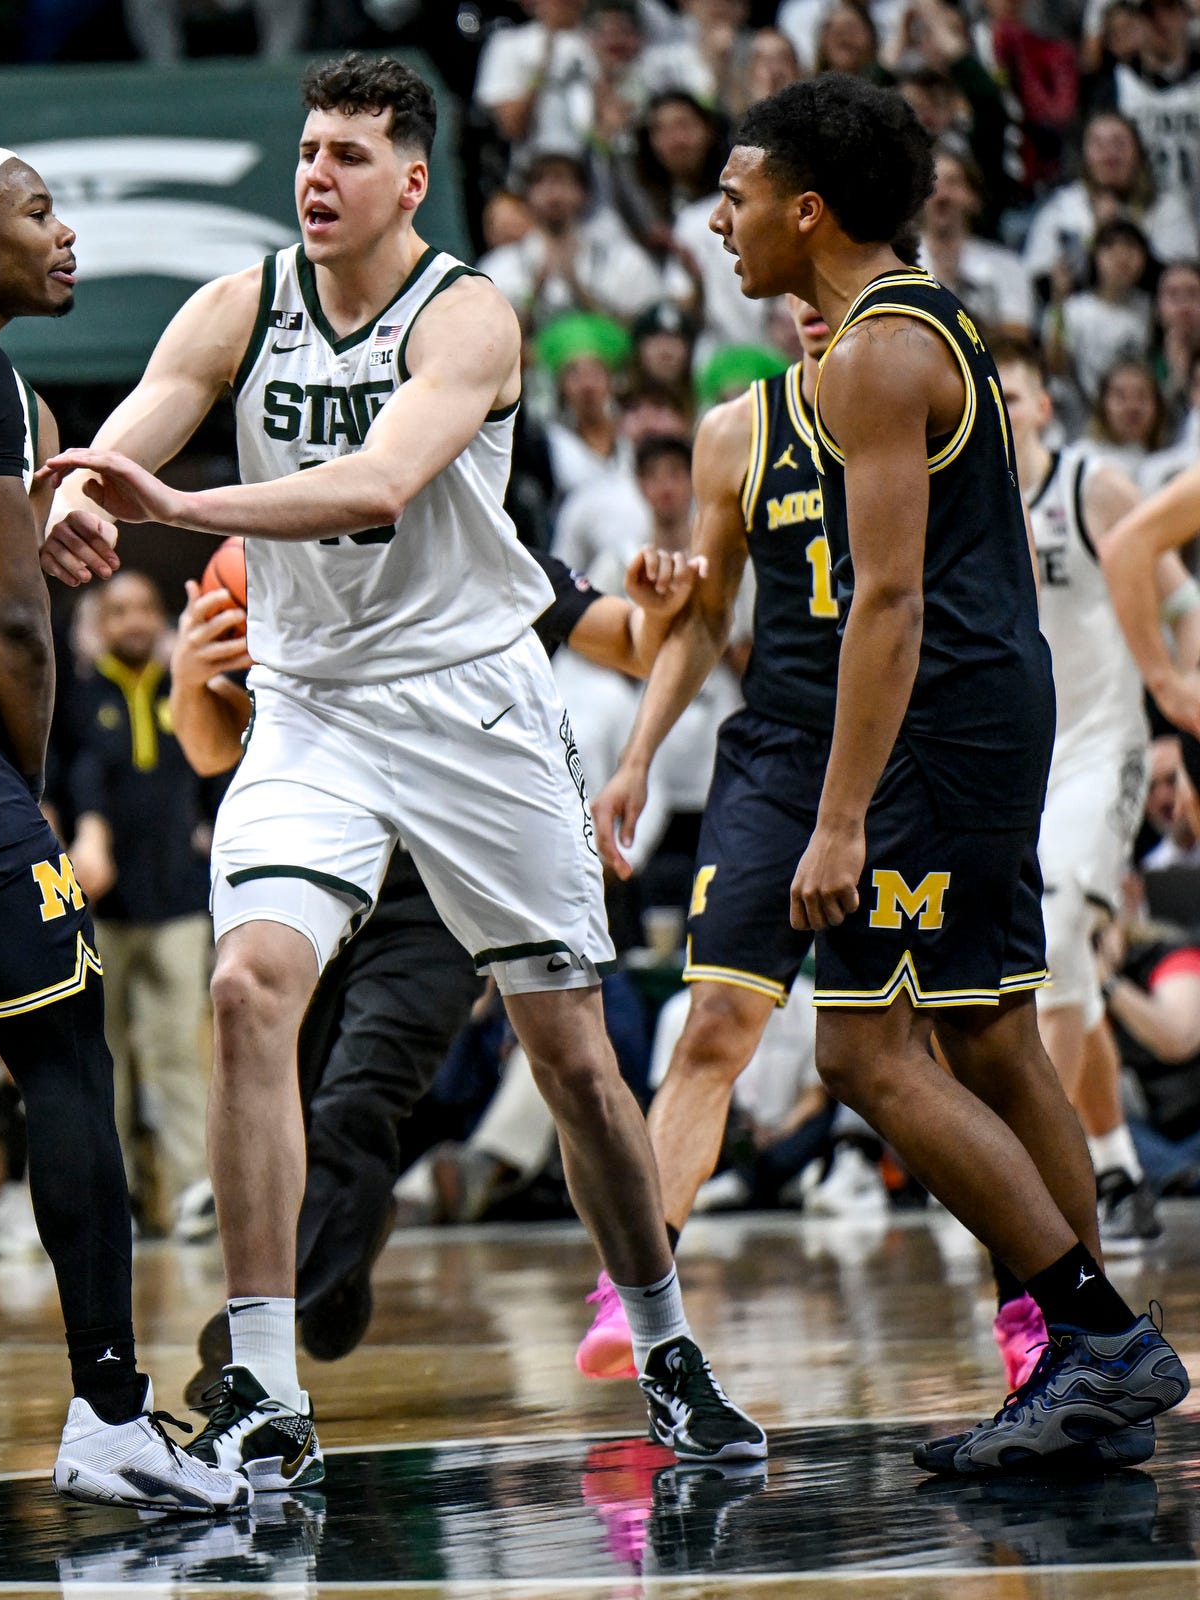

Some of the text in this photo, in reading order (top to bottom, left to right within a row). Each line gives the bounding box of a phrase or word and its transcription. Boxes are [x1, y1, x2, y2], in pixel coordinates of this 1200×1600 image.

[275, 311, 297, 329] JF
[31, 852, 86, 922] M
[869, 869, 951, 930] M
